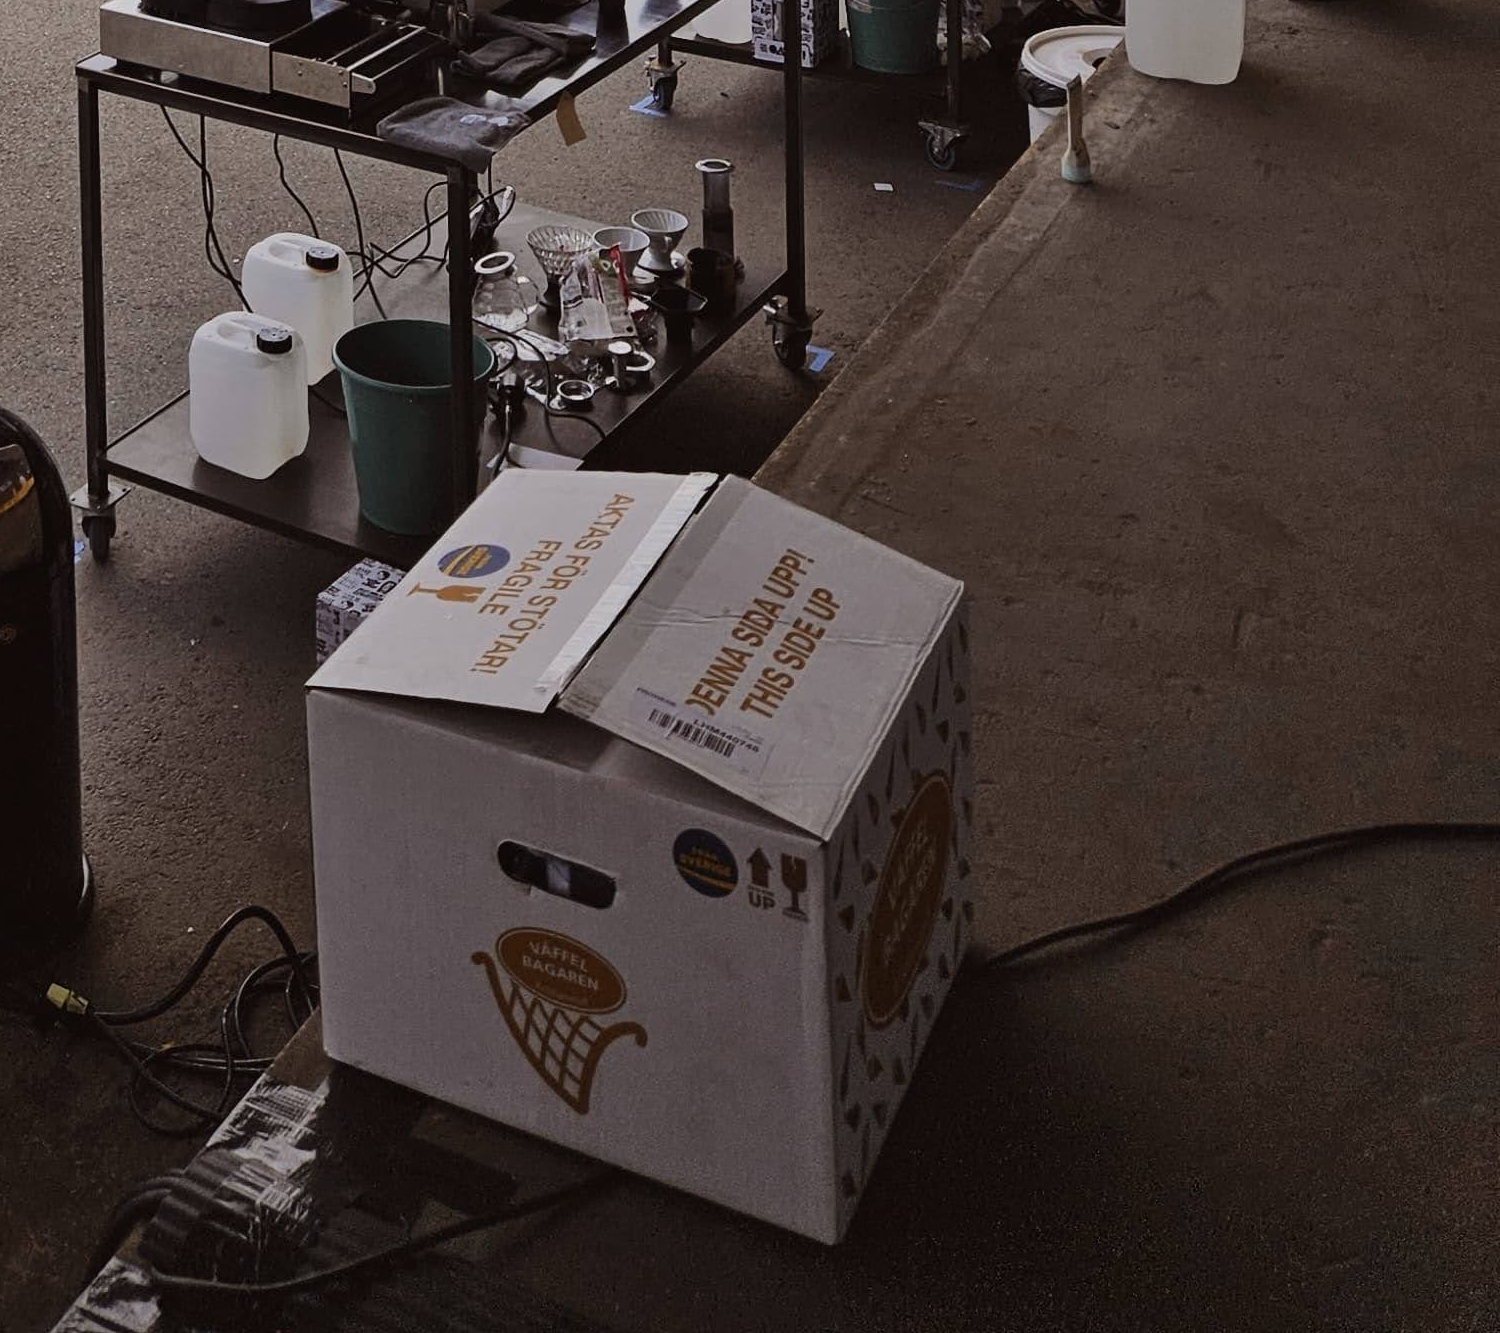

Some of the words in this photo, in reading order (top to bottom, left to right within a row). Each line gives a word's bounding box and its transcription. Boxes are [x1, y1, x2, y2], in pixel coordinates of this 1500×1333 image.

[574, 493, 635, 552] AKTAS
[477, 539, 564, 616] FRAGILE
[539, 554, 591, 592] FÖR
[731, 597, 787, 649] SIDA
[761, 547, 816, 600] UPP!
[469, 593, 558, 675] STÖTAR!
[739, 666, 796, 719] THIS
[772, 617, 827, 671] SIDE
[802, 586, 842, 622] UP
[747, 890, 777, 910] UP
[522, 954, 599, 991] BAGAREN
